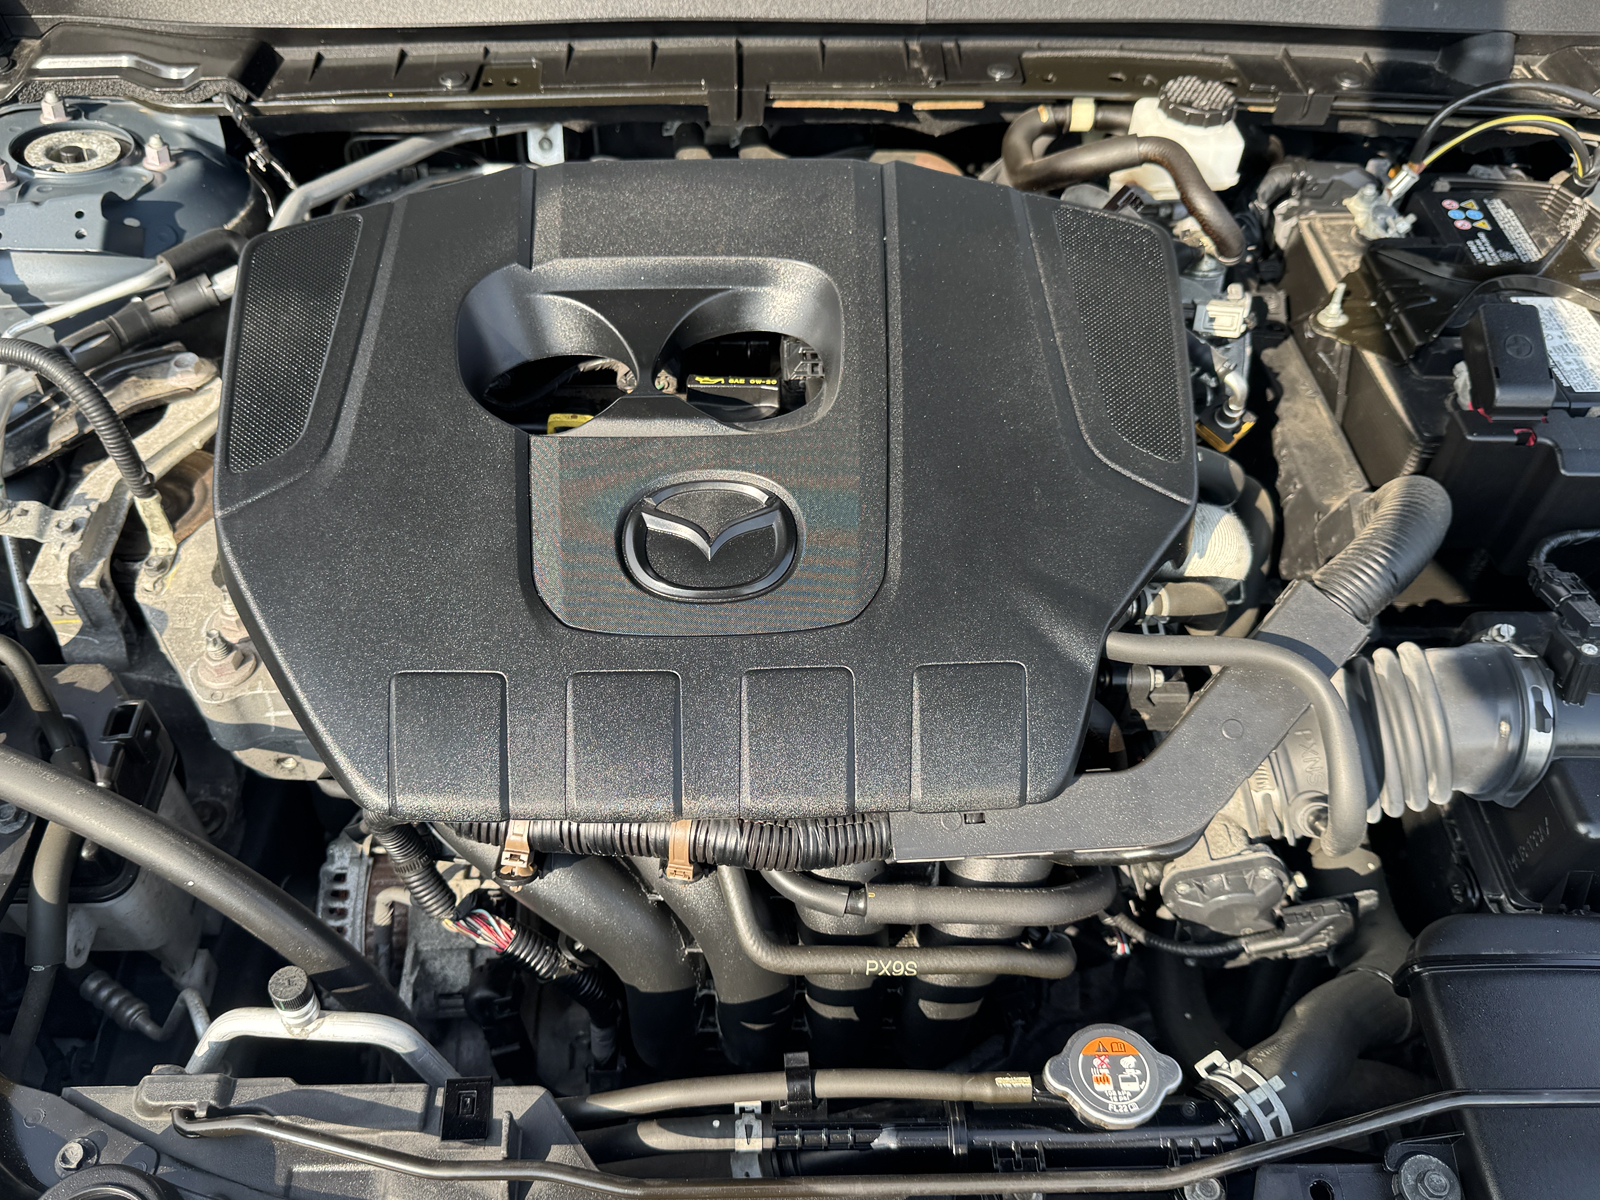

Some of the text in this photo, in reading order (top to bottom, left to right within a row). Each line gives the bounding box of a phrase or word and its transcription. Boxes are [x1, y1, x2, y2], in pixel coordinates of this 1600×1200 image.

[1294, 728, 1324, 786] PXNS
[865, 959, 917, 976] PX9S
[1108, 1103, 1128, 1112] FL22
